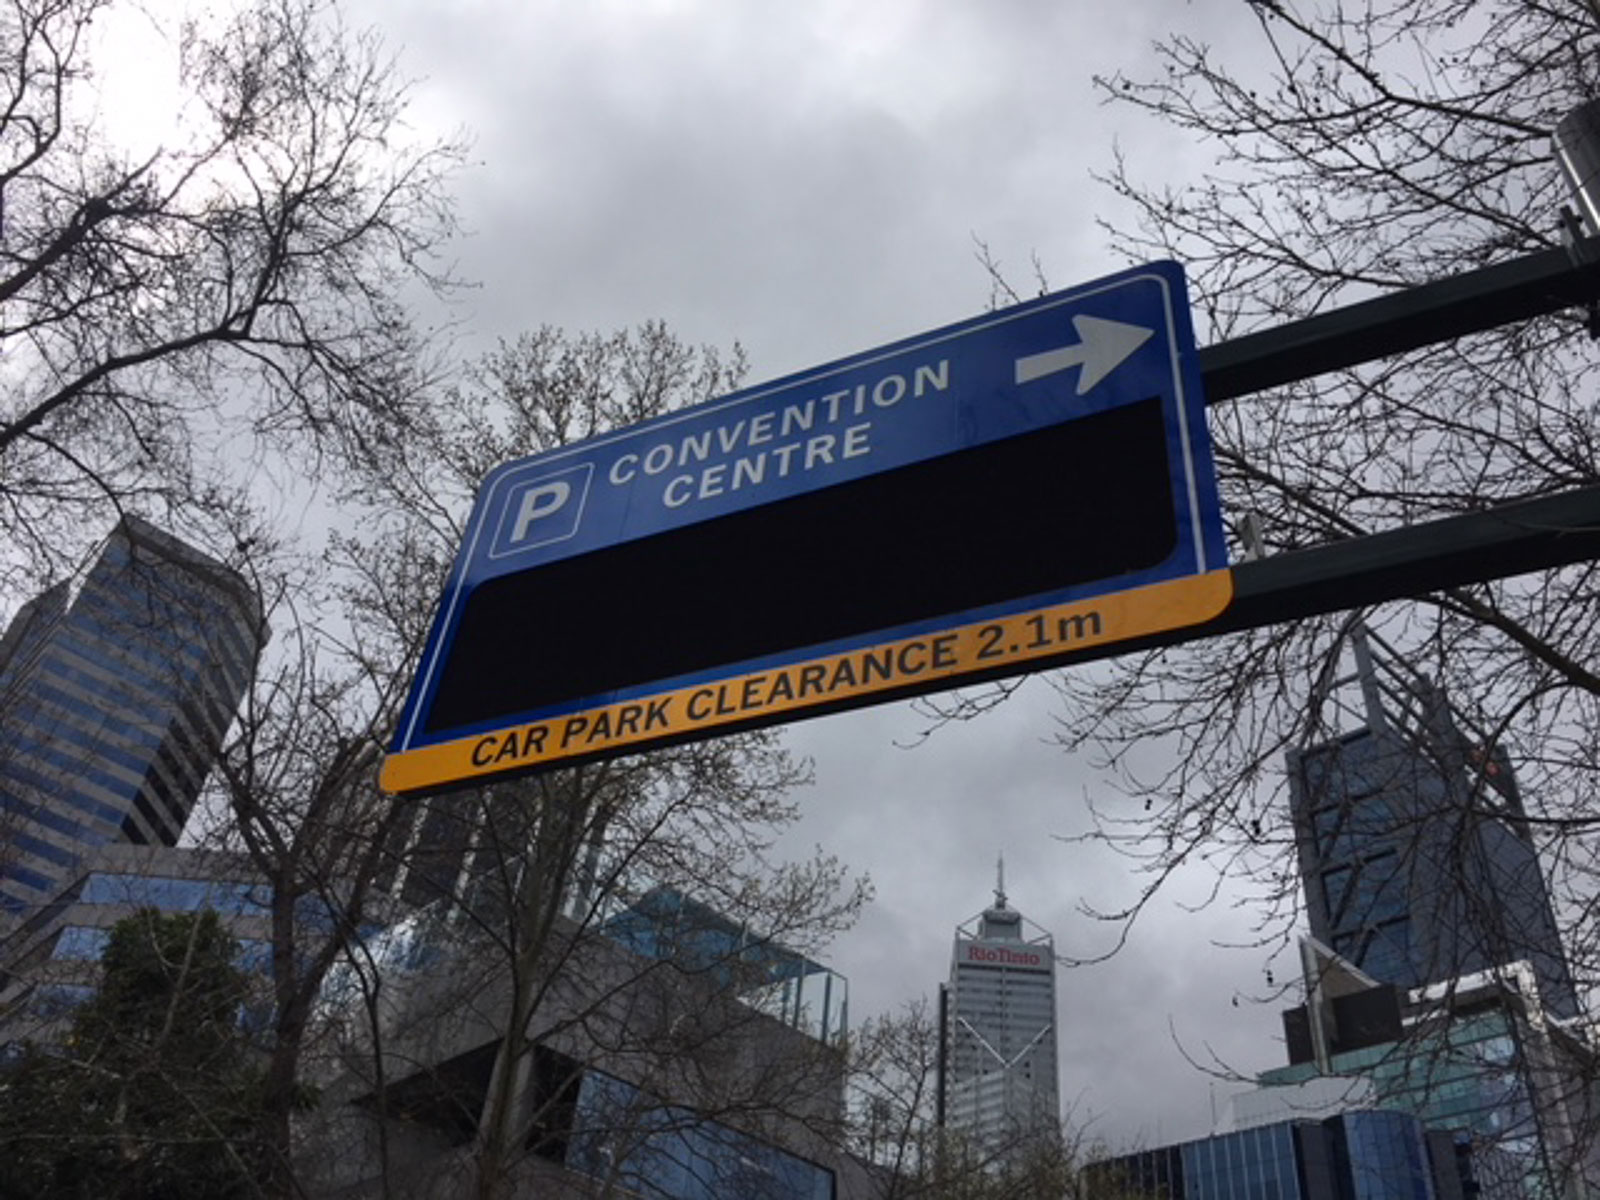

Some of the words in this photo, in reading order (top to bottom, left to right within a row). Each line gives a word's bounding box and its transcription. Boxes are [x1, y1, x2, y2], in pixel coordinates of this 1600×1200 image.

[608, 359, 950, 486] CONVENTION
[662, 422, 872, 509] CENTRE
[510, 480, 571, 543] P
[471, 724, 550, 767] CAR
[561, 696, 671, 751] PARK
[686, 634, 957, 720] CLEARANCE
[976, 609, 1103, 660] 2.1m
